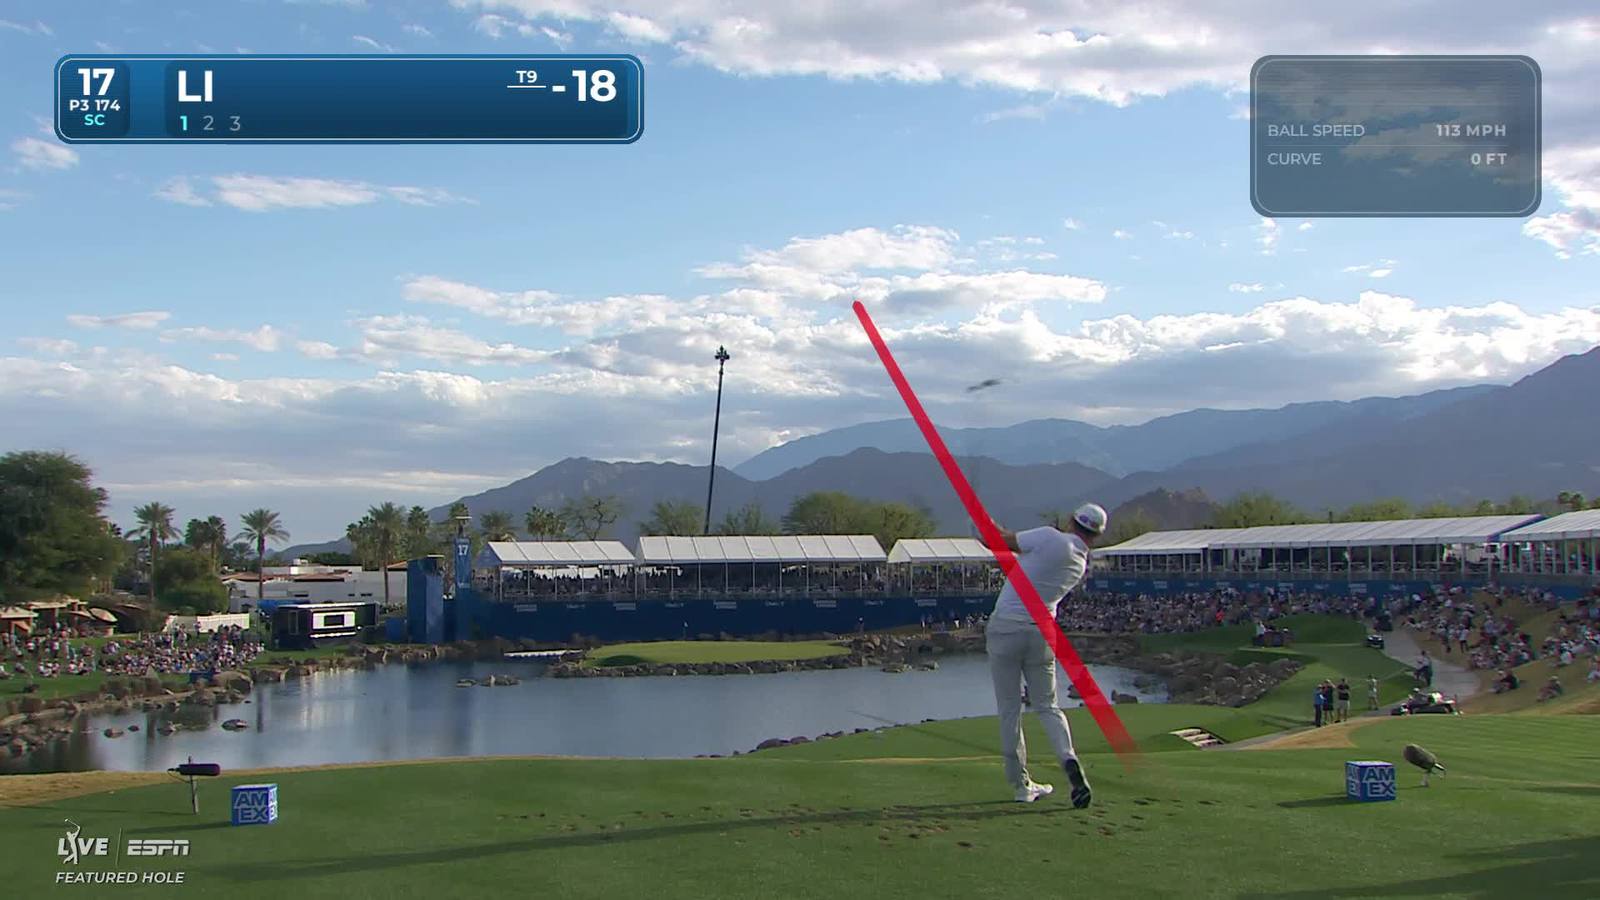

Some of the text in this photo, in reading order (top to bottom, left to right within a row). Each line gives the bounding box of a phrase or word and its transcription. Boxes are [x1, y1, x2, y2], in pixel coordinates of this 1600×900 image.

[458, 544, 469, 556] 17
[1362, 766, 1396, 783] AM
[1367, 781, 1396, 797] EX
[234, 790, 268, 809] AM
[239, 806, 268, 823] EX
